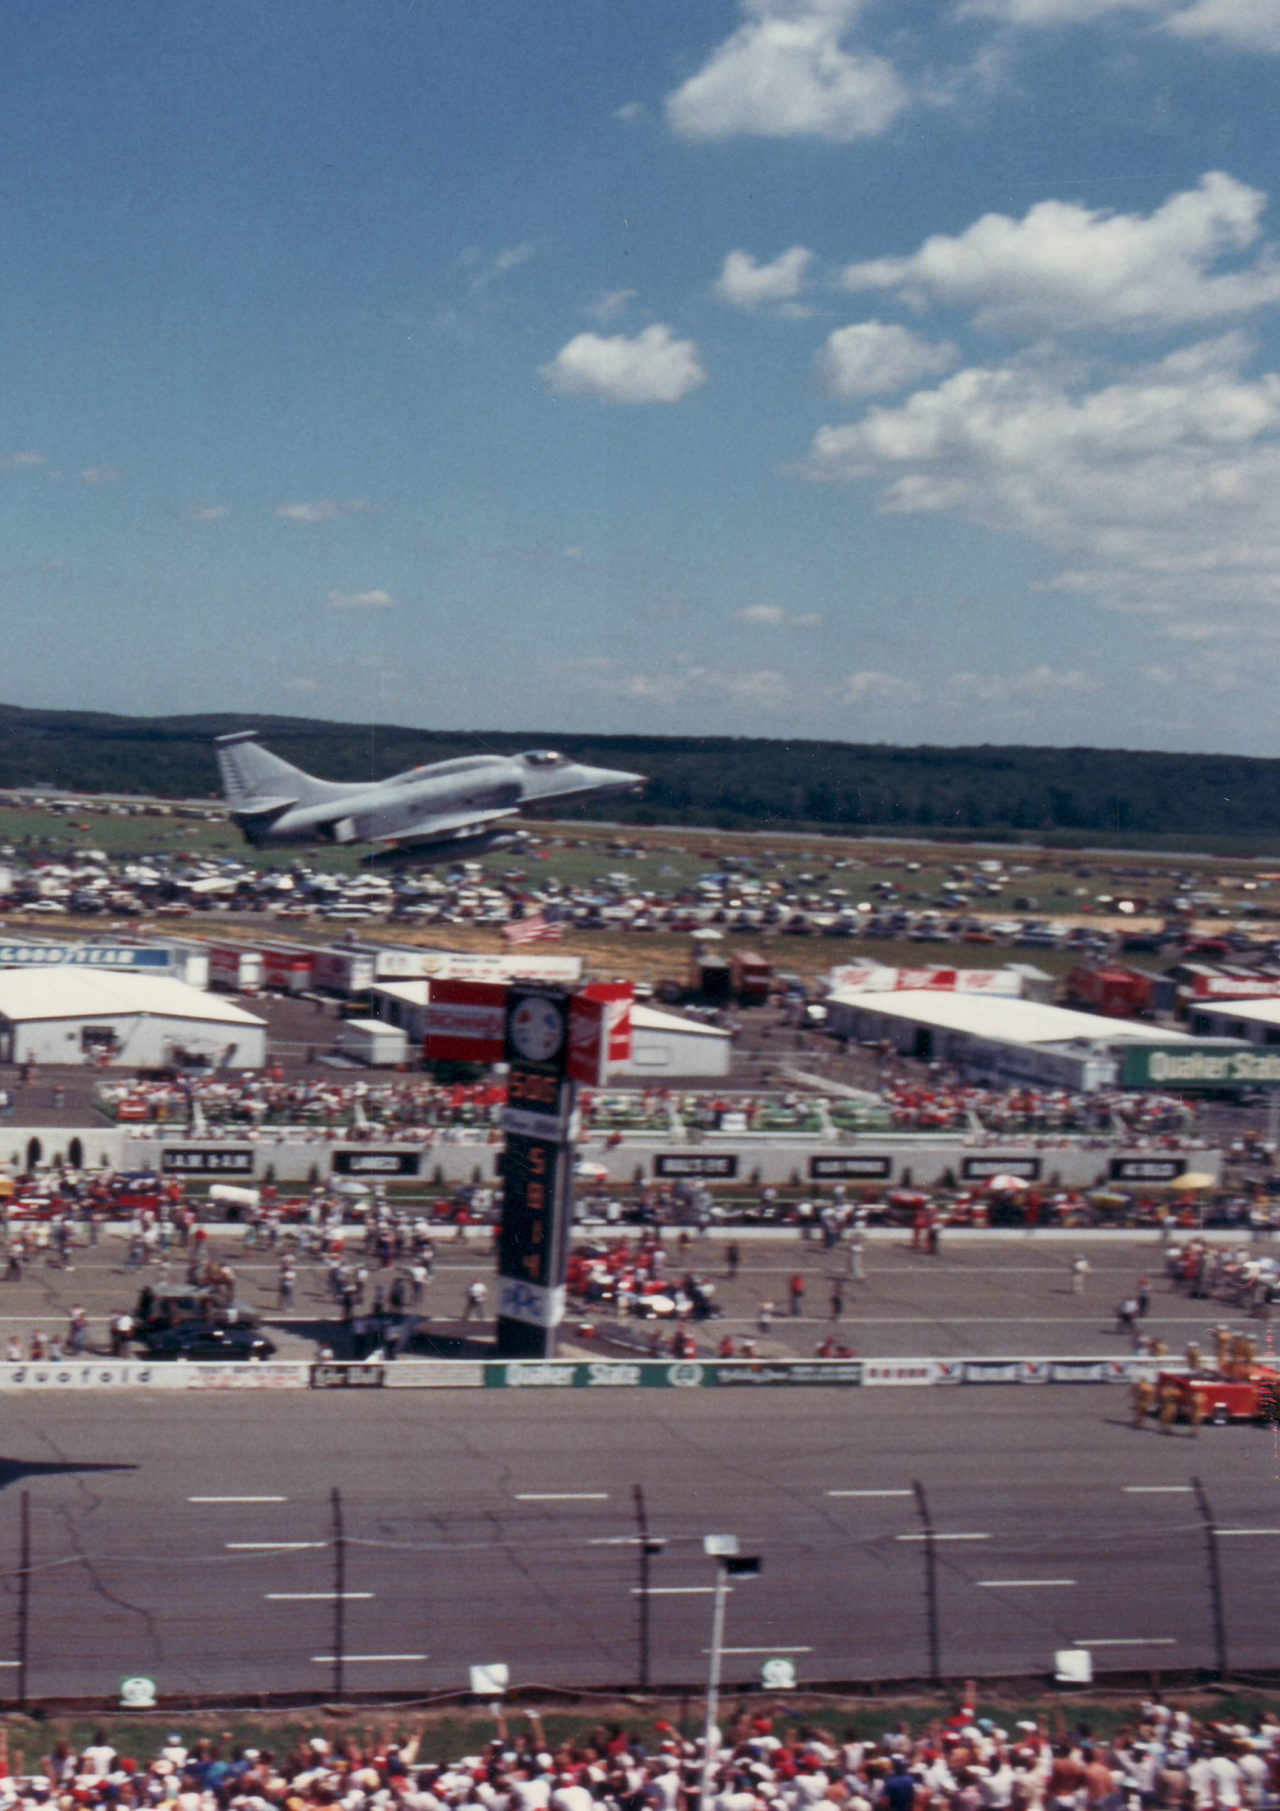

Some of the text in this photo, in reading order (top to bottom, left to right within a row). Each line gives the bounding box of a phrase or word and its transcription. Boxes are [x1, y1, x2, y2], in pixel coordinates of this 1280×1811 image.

[1148, 1052, 1280, 1081] Quaker Stat
[10, 1366, 152, 1383] duofold
[505, 1363, 642, 1386] Quaker State
